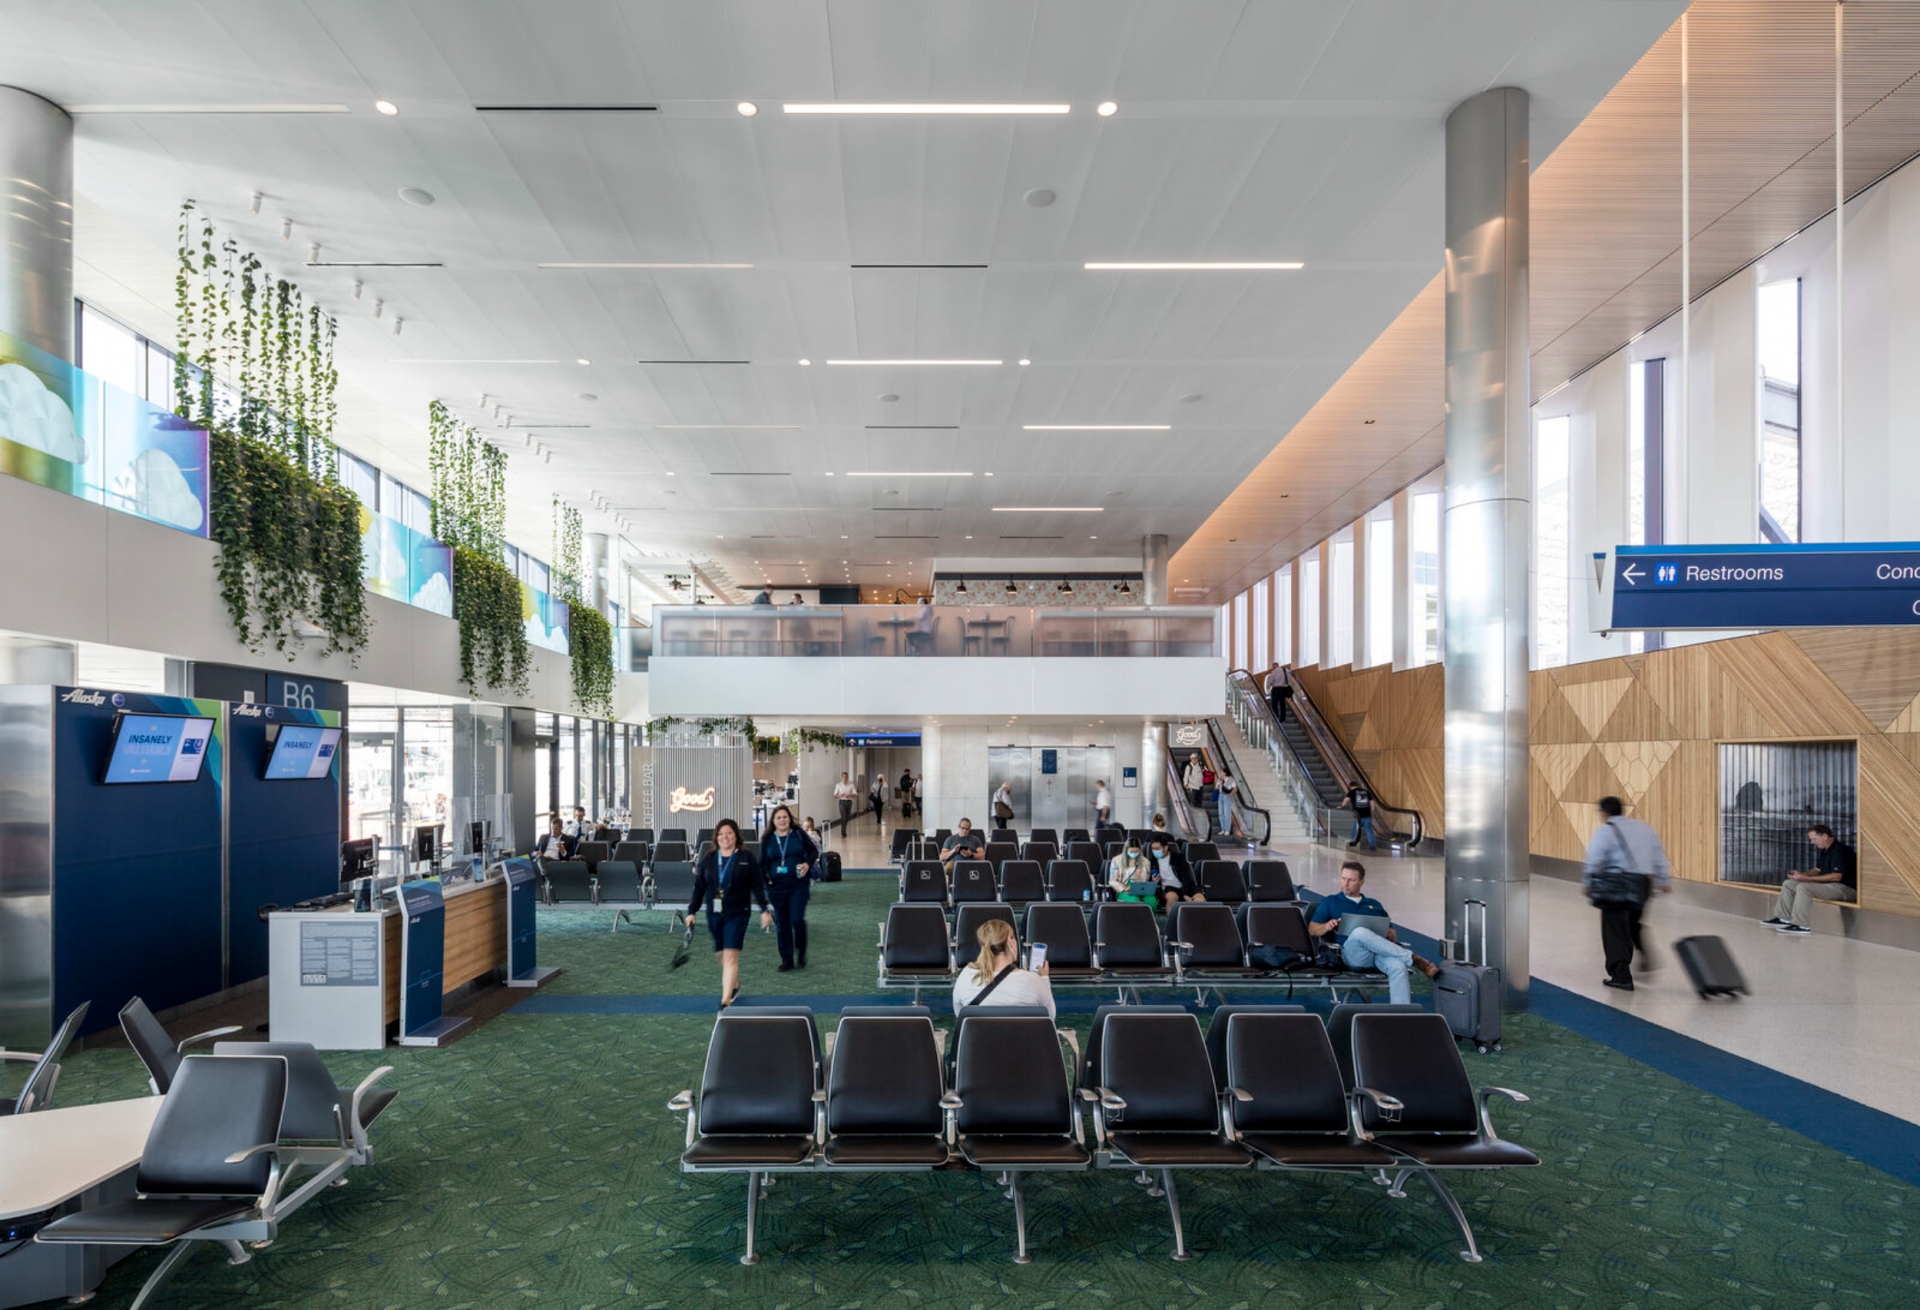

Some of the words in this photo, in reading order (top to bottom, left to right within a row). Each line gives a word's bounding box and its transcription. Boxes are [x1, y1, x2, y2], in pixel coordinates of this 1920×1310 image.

[1686, 565, 1784, 581] Restrooms
[61, 688, 106, 706] Alaska
[283, 681, 315, 709] B6
[128, 734, 172, 744] INSANELY
[283, 740, 314, 749] INSANELY
[643, 763, 653, 786] BAR
[669, 786, 715, 813] Good
